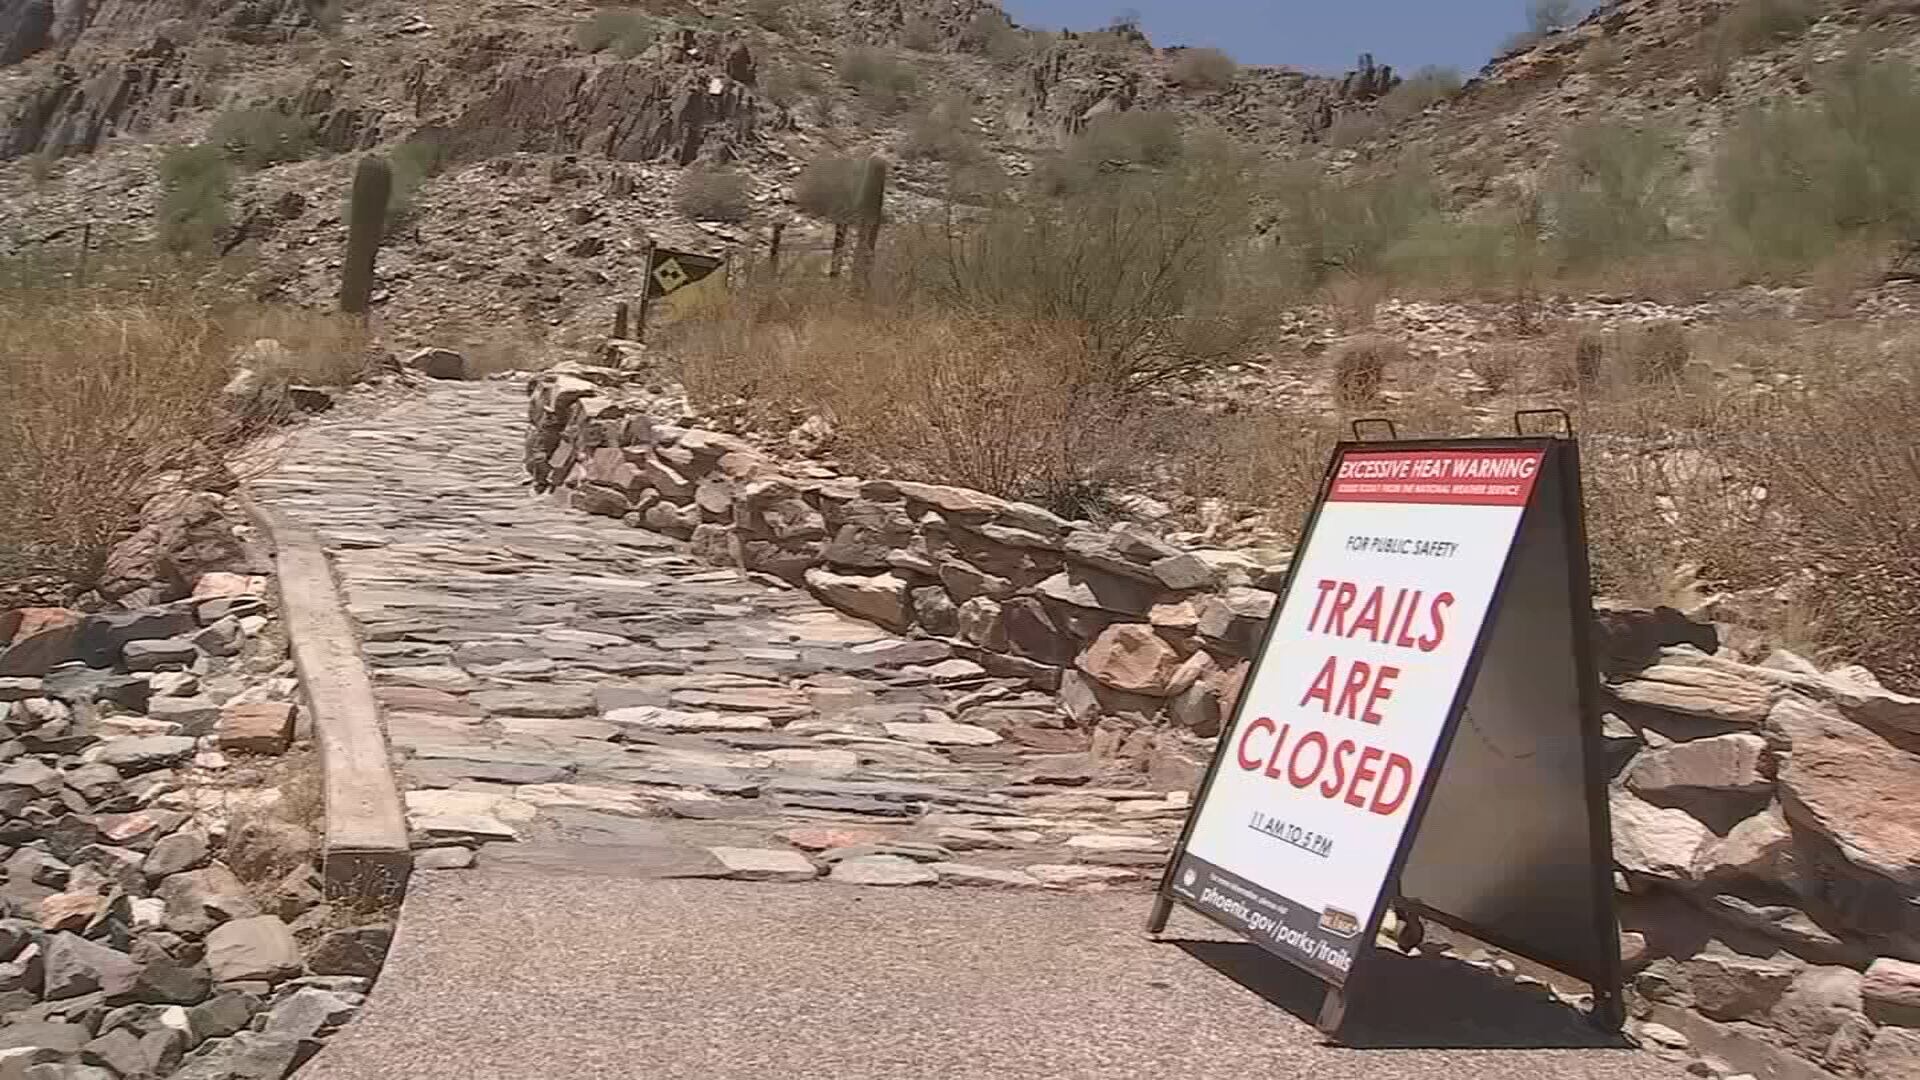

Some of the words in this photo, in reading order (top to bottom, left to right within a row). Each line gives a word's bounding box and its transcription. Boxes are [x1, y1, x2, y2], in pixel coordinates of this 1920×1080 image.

[1339, 460, 1411, 479] EXCESSIVE
[1412, 459, 1451, 478] HEAT
[1452, 457, 1536, 479] WARNING
[1346, 536, 1370, 551] FOR
[1371, 537, 1411, 554] PUBLIC
[1412, 540, 1459, 557] SAFETY
[1307, 579, 1455, 652] TRAILS
[1299, 655, 1400, 725] ARE
[1237, 717, 1413, 816] CLOSED
[1251, 811, 1265, 828] 11
[1264, 817, 1286, 836] AM
[1286, 823, 1302, 842] TO
[1302, 831, 1314, 848] 5
[1312, 834, 1334, 855] PM
[1200, 887, 1353, 972] phoenix.gov/parks/trails
